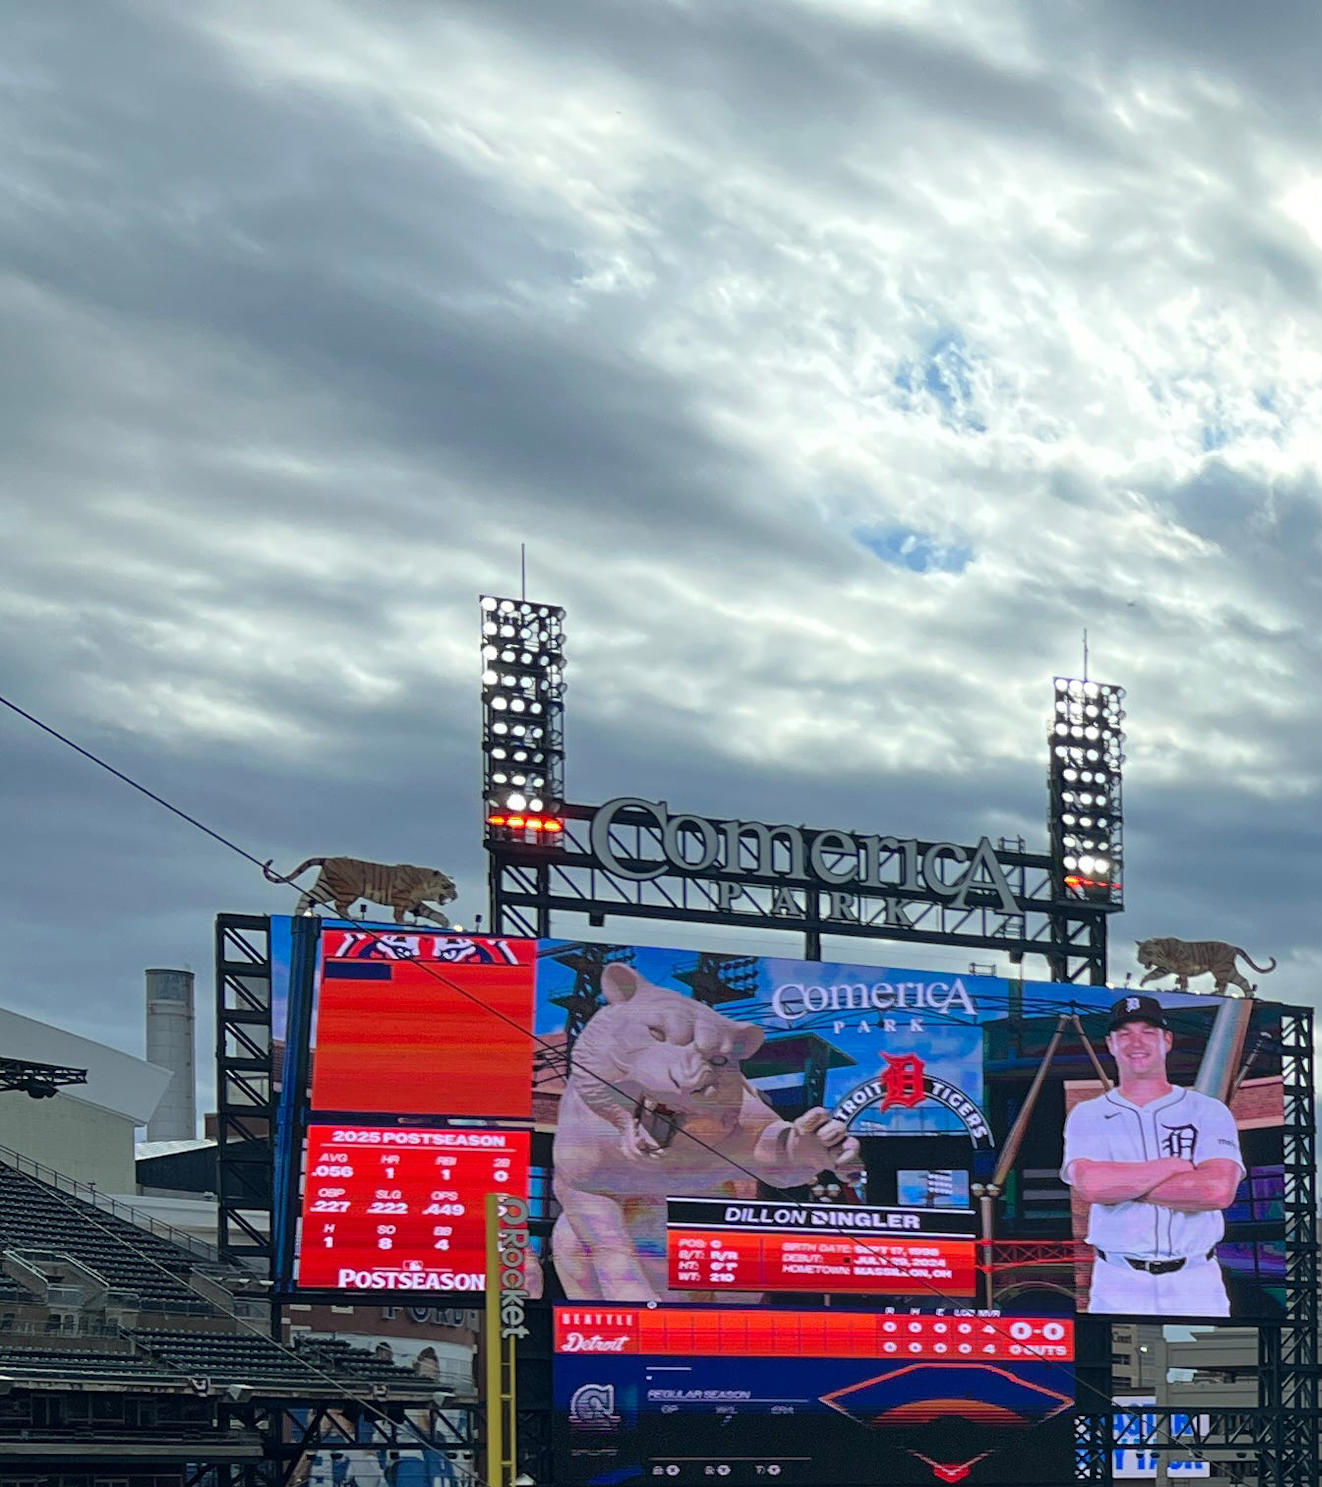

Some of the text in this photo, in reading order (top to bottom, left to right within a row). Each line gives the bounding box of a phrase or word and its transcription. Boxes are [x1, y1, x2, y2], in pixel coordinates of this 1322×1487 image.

[719, 882, 913, 927] PARK
[834, 1018, 925, 1034] PARK
[932, 1082, 988, 1141] TIGERS
[332, 1131, 505, 1146] 2025 POSTSEASON
[319, 1153, 348, 1163] AVG
[380, 1155, 399, 1164] HR
[385, 1168, 394, 1179] 1
[441, 1169, 450, 1180] 1
[494, 1171, 509, 1182] 0
[317, 1188, 458, 1201] OBP SLG OPS
[725, 1207, 921, 1229] DILLON DINGLER
[323, 1224, 335, 1233] H
[377, 1225, 396, 1234] SO
[324, 1237, 333, 1248] 1
[434, 1239, 449, 1250] 4
[338, 1269, 486, 1291] POSTSEASON
[562, 1314, 1064, 1340] SEATTLE 0-0
[562, 1332, 630, 1352] Detroit
